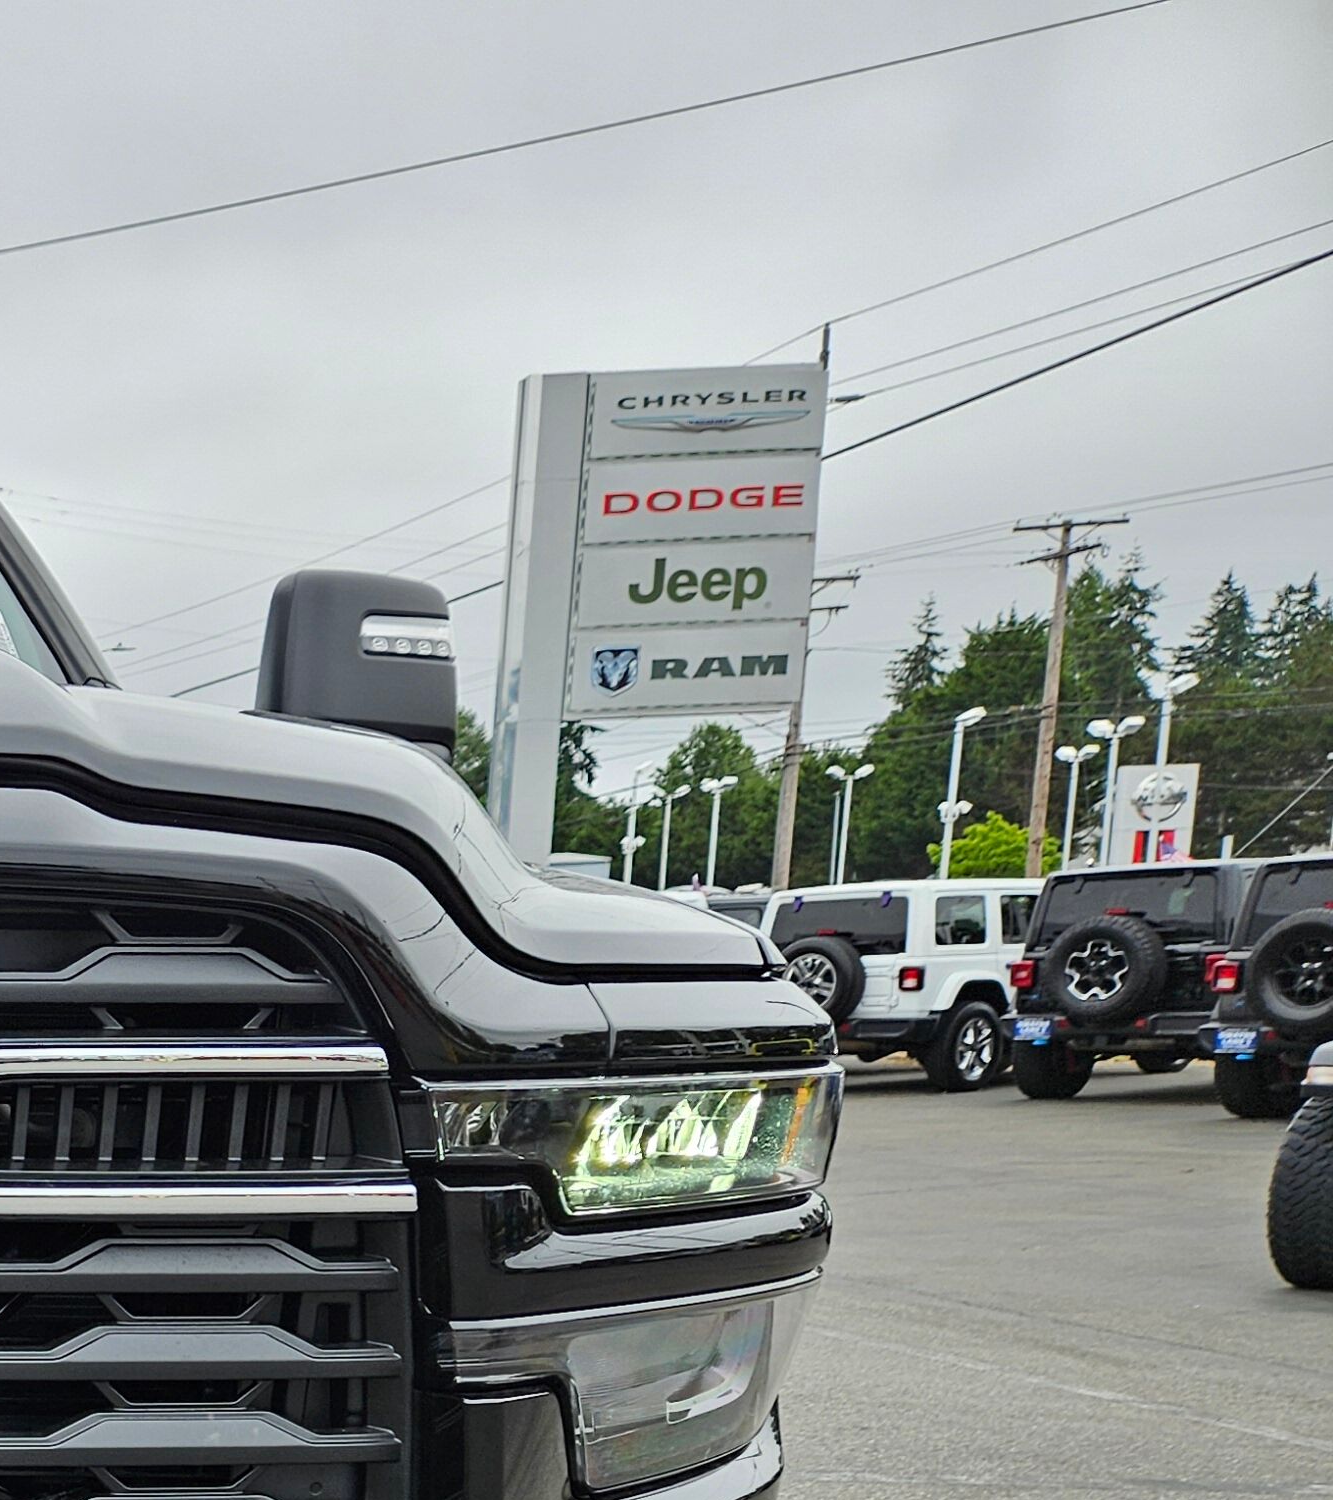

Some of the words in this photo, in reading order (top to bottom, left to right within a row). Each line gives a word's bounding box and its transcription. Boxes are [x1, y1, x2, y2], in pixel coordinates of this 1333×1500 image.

[617, 389, 808, 410] CHRYSLER
[602, 483, 806, 516] DODGE
[628, 557, 768, 611] Jeep
[649, 653, 790, 680] RAM
